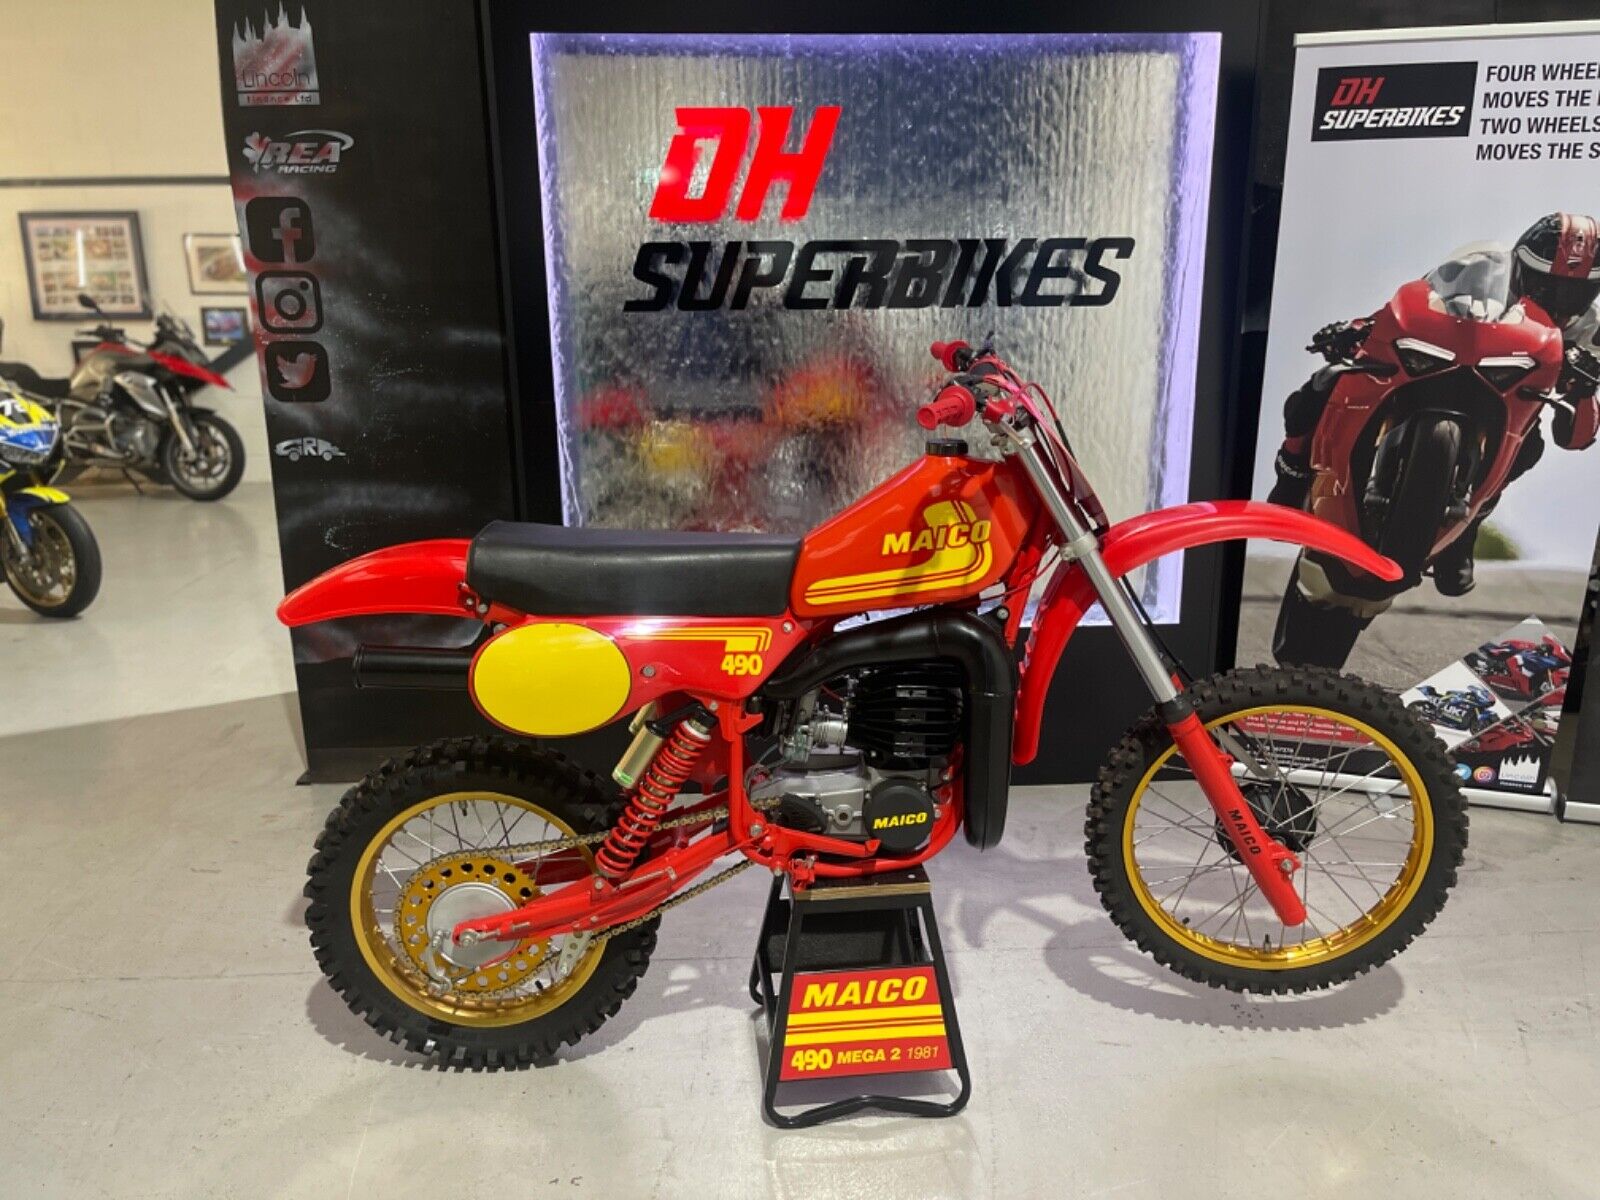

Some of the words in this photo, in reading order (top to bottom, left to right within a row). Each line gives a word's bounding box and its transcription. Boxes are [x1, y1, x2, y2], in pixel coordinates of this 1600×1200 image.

[242, 68, 311, 88] Lincoln
[1486, 64, 1536, 82] FOUR
[1330, 77, 1386, 105] DH
[1482, 90, 1549, 109] MOVES
[1555, 89, 1592, 107] THE
[1319, 105, 1466, 130] SUPERBIKES
[1480, 117, 1521, 135] TWO
[1527, 115, 1600, 134] WHEELS
[261, 142, 341, 163] REA
[1476, 143, 1542, 160] MOVES
[1547, 142, 1584, 159] THE
[277, 165, 337, 174] RACING
[648, 105, 843, 223] DH
[622, 236, 1136, 312] SUPERBIKES
[882, 520, 992, 556] MAICO
[721, 654, 763, 676] 490
[873, 812, 927, 829] MAICO
[1228, 809, 1262, 855] MAICO
[802, 975, 928, 1009] MAICO
[791, 1048, 833, 1072] 490
[836, 1050, 886, 1065] MEGA
[890, 1048, 901, 1062] 2
[907, 1045, 939, 1060] 1981
